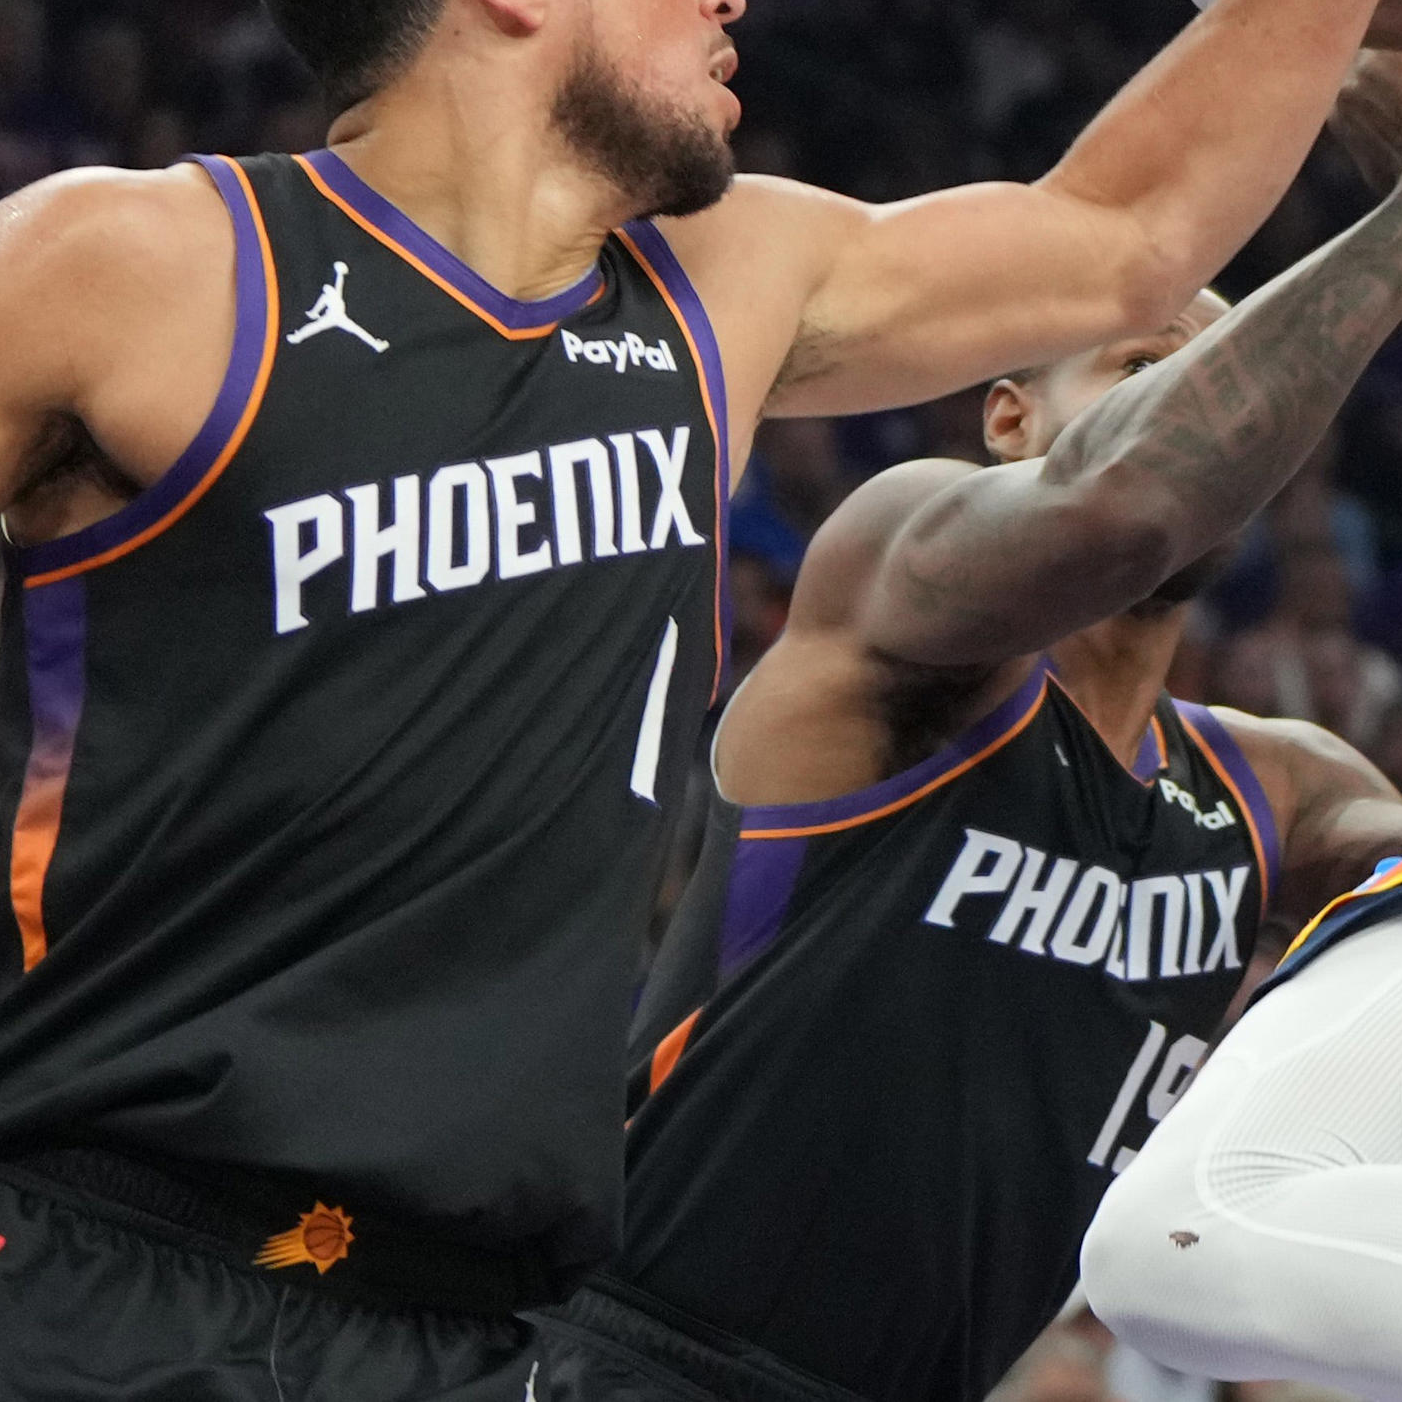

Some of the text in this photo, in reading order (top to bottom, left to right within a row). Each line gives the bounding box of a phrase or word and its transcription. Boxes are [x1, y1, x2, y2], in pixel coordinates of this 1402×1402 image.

[560, 328, 678, 374] PayPal
[263, 426, 706, 635] PHOENIX
[629, 614, 679, 804] 1
